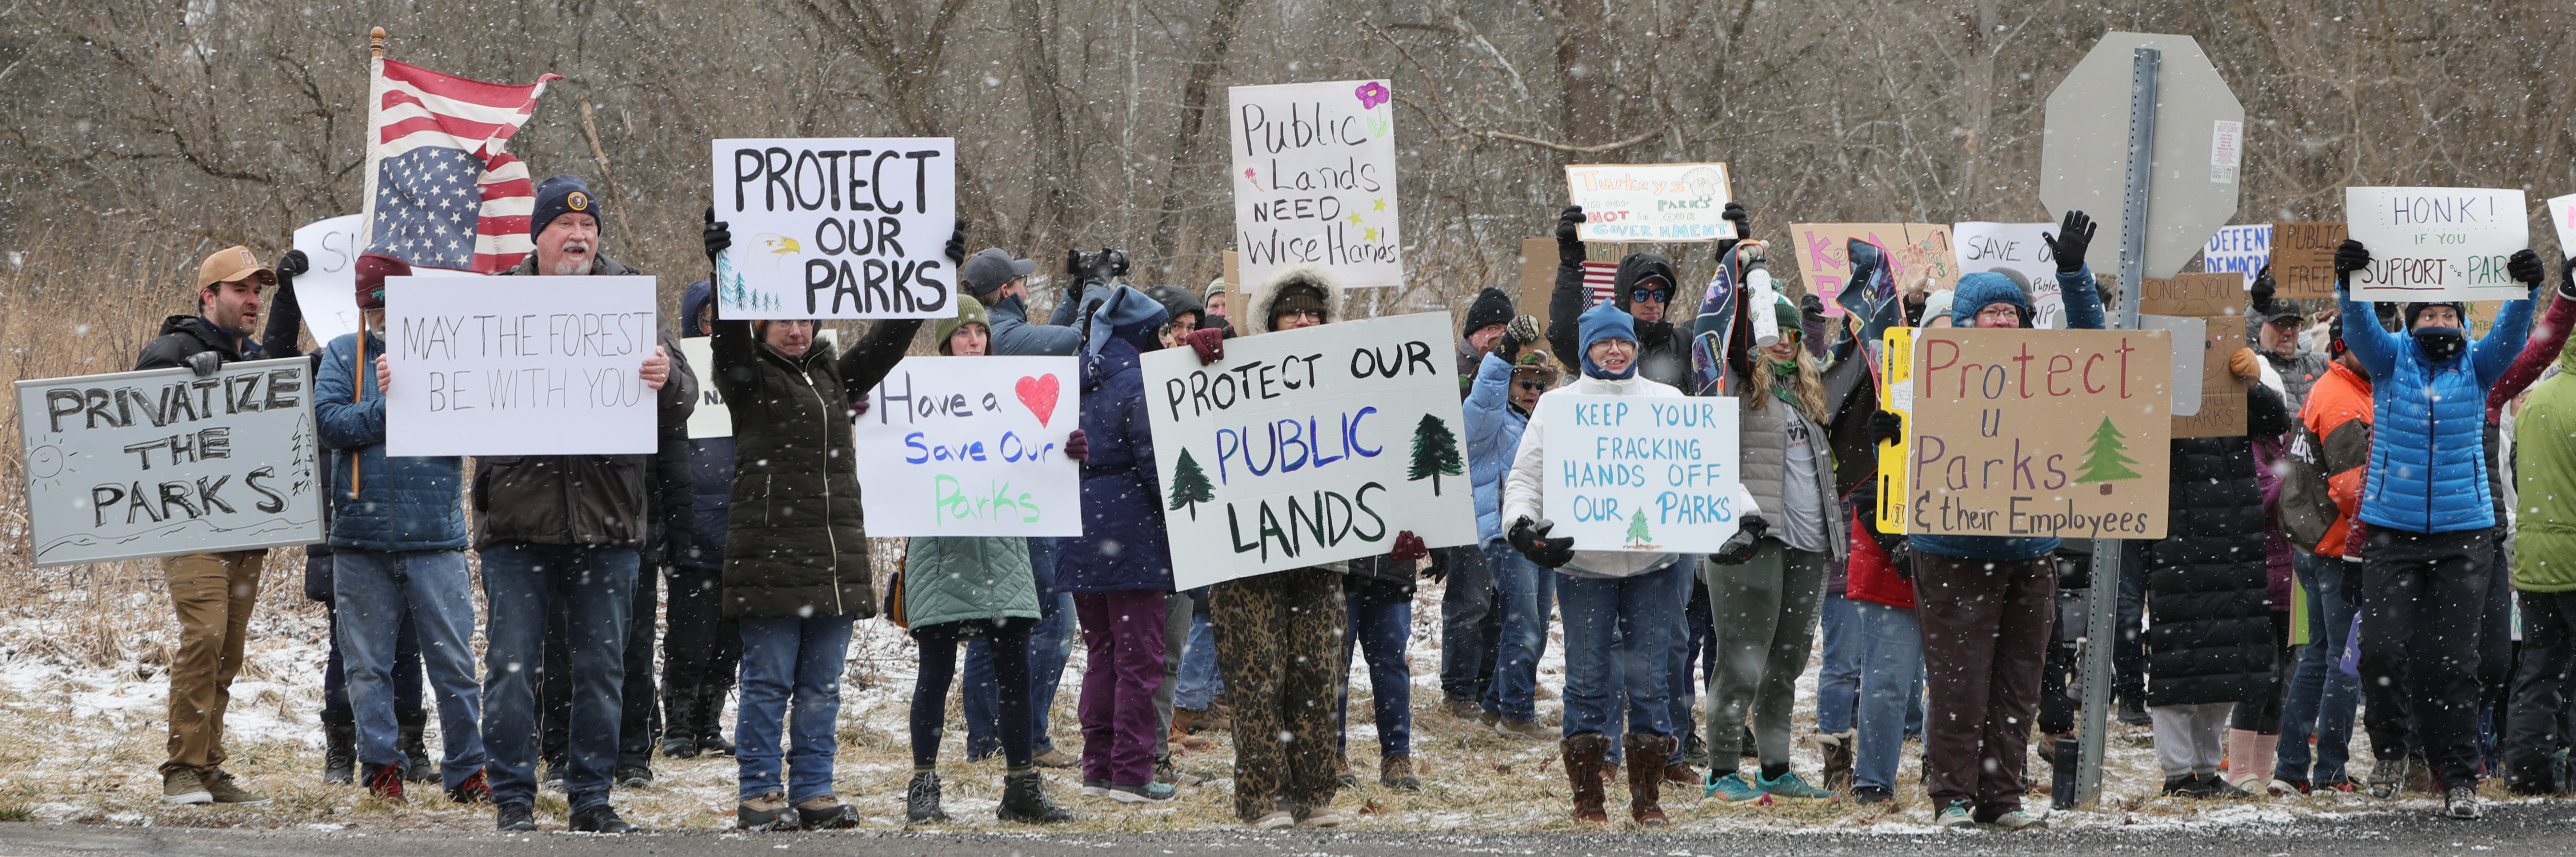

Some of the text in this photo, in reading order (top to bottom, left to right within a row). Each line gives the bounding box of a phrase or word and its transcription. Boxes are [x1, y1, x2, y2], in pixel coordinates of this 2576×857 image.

[1242, 102, 1367, 156] Public
[735, 147, 940, 215] PROTECT
[1272, 156, 1380, 193] Lands
[1574, 171, 1684, 195] Turkeys
[1254, 197, 1340, 222] NEED
[1583, 198, 1710, 212] in our PARKS
[1588, 211, 1695, 224] NOT in OUR
[2394, 197, 2476, 225] HONK
[816, 217, 904, 258] OUR
[1244, 222, 1395, 265] Wise Hands
[1967, 236, 2021, 261] SAVE
[2286, 224, 2342, 250] PUBLIC
[2415, 233, 2466, 245] IF YOU
[805, 258, 947, 314] PARKS
[2033, 277, 2059, 292] Public
[2146, 277, 2232, 301] ONLY YOU
[2288, 266, 2337, 294] FREE
[2362, 255, 2514, 285] SUPPORT OUR PAR
[403, 312, 653, 360] MAY THE FOREST
[1167, 341, 1436, 422] PROTECT OUR
[1925, 337, 2136, 399] Protect
[46, 368, 301, 433] PRIVATIZE
[430, 368, 641, 412] BE WITH YOU
[879, 371, 1001, 425] Have a
[1576, 403, 1717, 429] KEEP YOUR
[124, 426, 231, 470] THE
[905, 431, 1054, 464] Save Our
[1217, 406, 1383, 485] PUBLIC
[1597, 437, 1701, 460] FRACKING
[1916, 435, 2067, 491] Parks
[1564, 460, 1721, 488] HANDS OFF
[92, 466, 290, 528] PARKS
[935, 475, 1040, 527] Parks
[1573, 491, 1731, 525] OUR PARKS
[1228, 482, 1387, 564] LANDS
[1940, 496, 2000, 532] their
[2009, 496, 2148, 539] Employees
